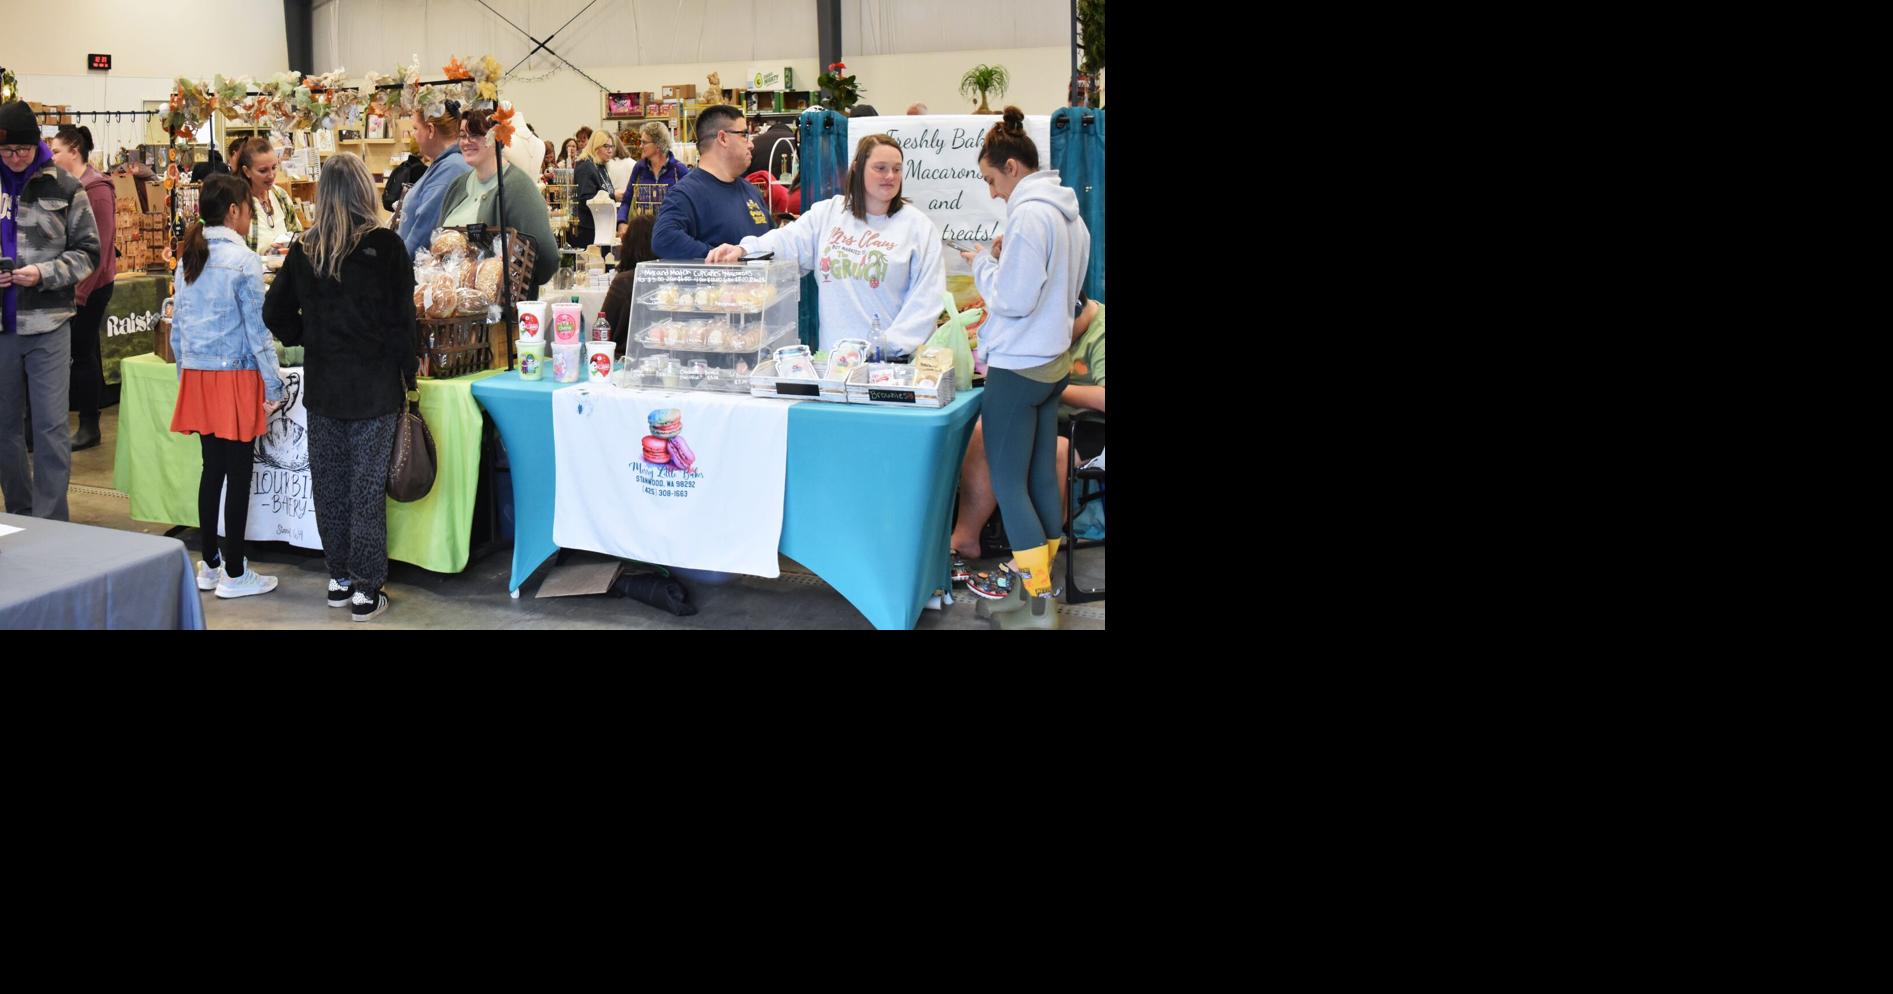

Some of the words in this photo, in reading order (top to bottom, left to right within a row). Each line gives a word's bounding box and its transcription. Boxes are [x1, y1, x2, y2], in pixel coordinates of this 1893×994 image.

[952, 128, 985, 149] Bak
[928, 190, 963, 210] and
[942, 221, 999, 241] treats!
[107, 310, 154, 337] Raisi
[252, 470, 312, 499] LOURBI
